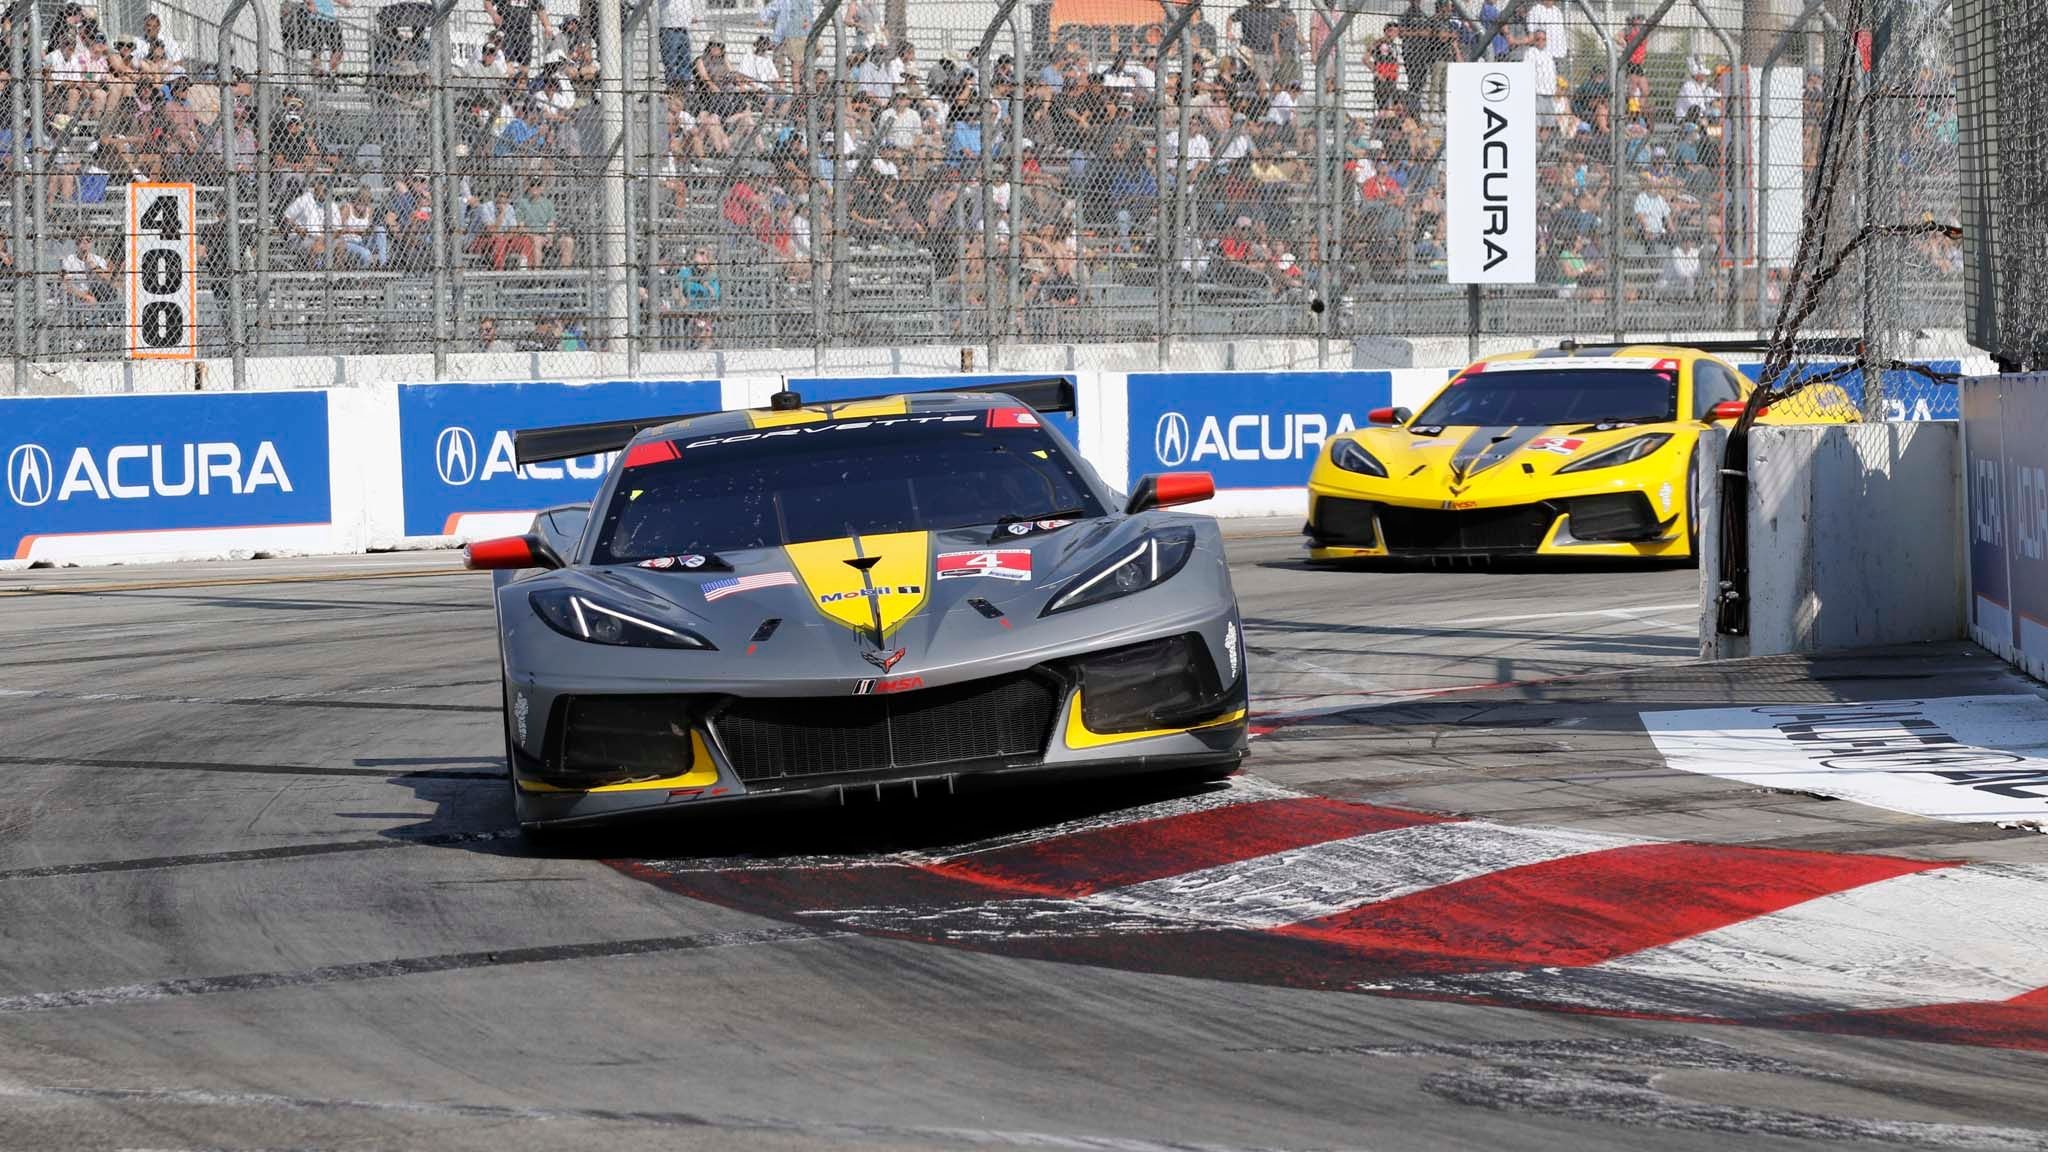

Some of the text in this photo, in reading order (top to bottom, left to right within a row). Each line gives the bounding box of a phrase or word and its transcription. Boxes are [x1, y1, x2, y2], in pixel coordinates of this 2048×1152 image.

[1483, 107, 1509, 273] ACURA
[139, 195, 184, 349] 400
[686, 415, 977, 449] CORVETTE
[57, 441, 294, 501] ACURA
[2015, 465, 2048, 561] ACUR
[966, 553, 1003, 567] 4
[820, 586, 890, 603] Mobil
